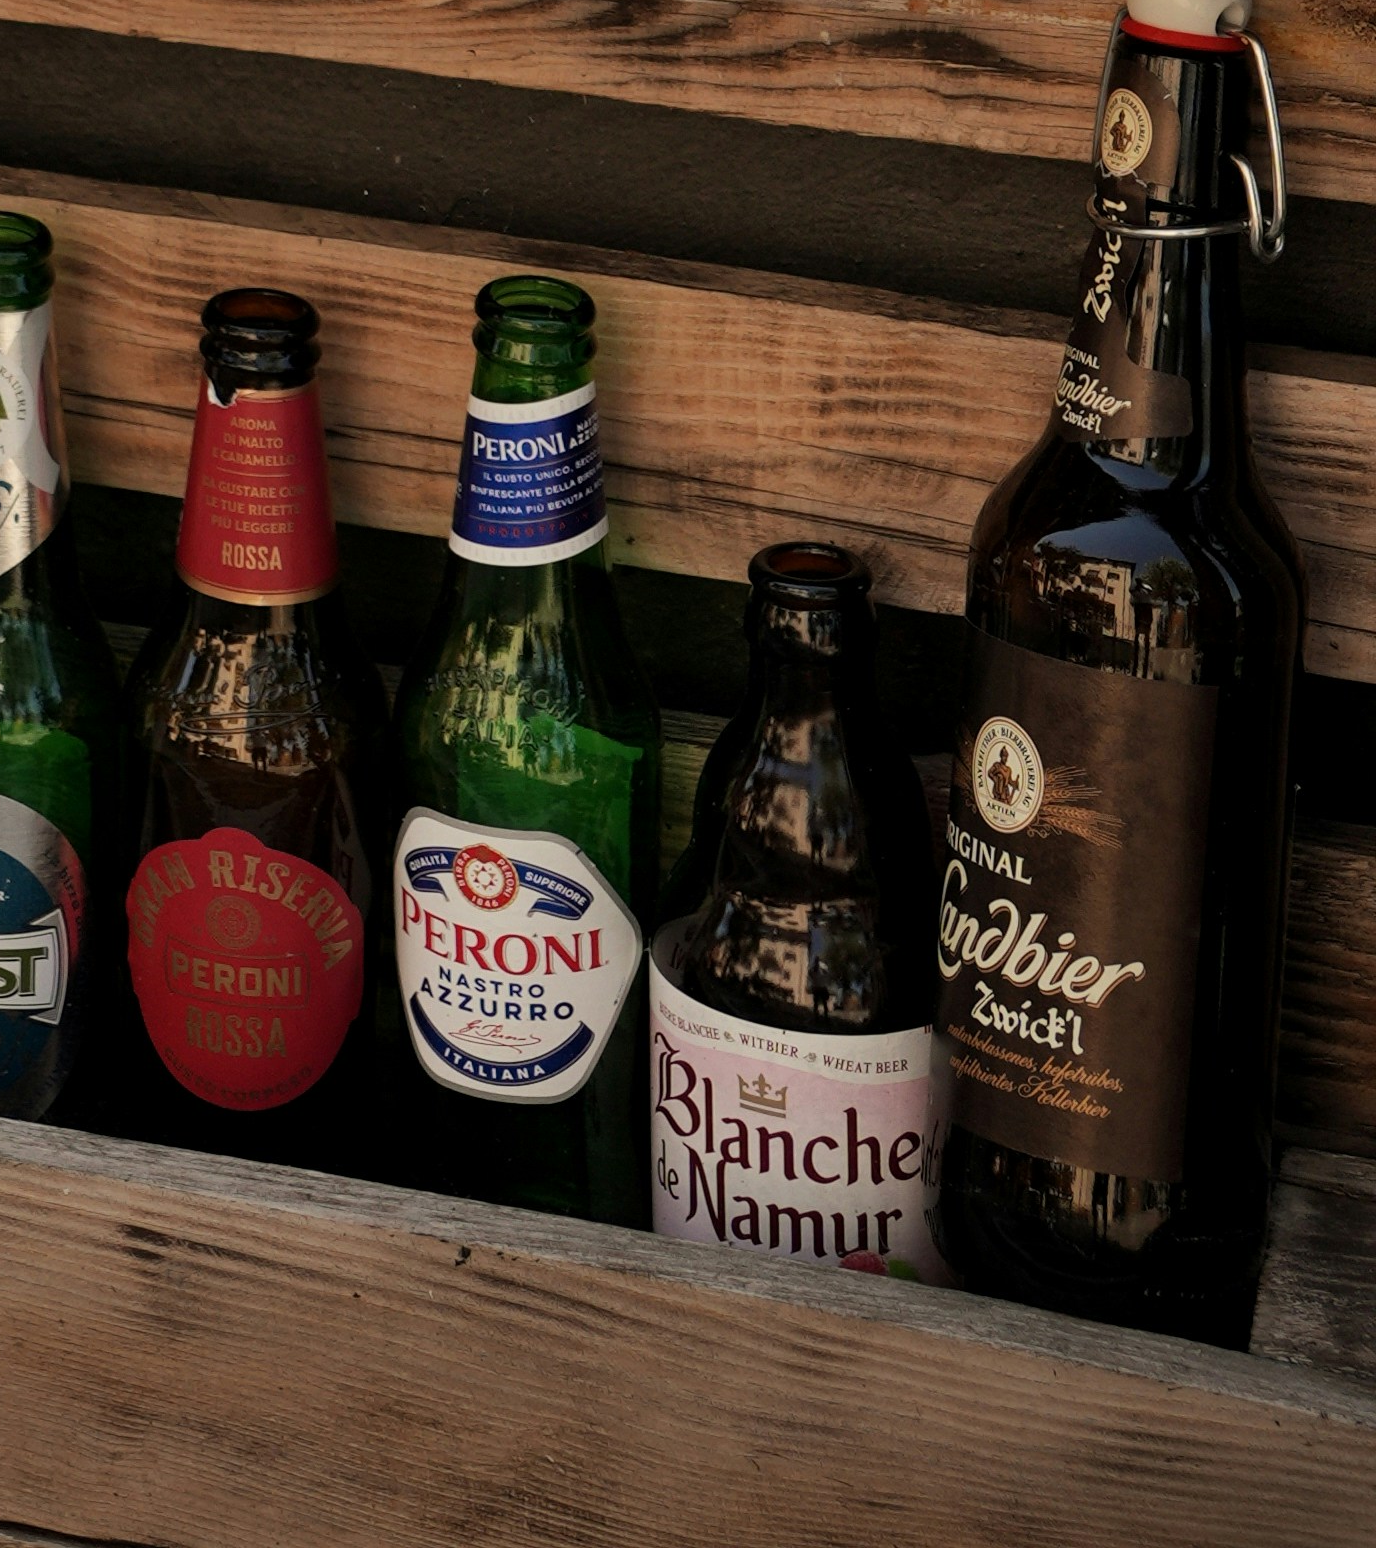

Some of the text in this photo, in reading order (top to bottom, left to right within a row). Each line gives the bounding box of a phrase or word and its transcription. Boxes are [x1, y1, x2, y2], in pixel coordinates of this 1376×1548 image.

[229, 416, 278, 432] AROMA
[220, 449, 298, 467] CARAMELLO
[238, 435, 284, 450] MALTO
[471, 430, 567, 462] PERONI
[217, 479, 278, 500] GUSTARE
[220, 498, 247, 513] TUE
[544, 479, 577, 497] DELLA
[477, 501, 525, 515] ITALIANA
[234, 520, 296, 535] LEGGERE
[220, 539, 284, 572] ROSSA
[408, 852, 589, 908] QUALITÀ SUPERIORE
[456, 850, 519, 900] BIRRA PERONI
[130, 848, 355, 972] GRAN RISERVA
[470, 894, 500, 909] 1846
[400, 884, 606, 978] PERONI
[936, 857, 1146, 1010] Landbier
[169, 949, 304, 999] PERONI
[438, 964, 546, 1000] NASTRO
[419, 975, 575, 1022] AZZURRO
[184, 1004, 289, 1060] ROSSA
[676, 1017, 910, 1076] BLANCHE WITBIER WHEAT BEER
[442, 1046, 547, 1082] ITALIANA
[654, 1029, 923, 1188] Blanche
[656, 1138, 904, 1260] de Namur
